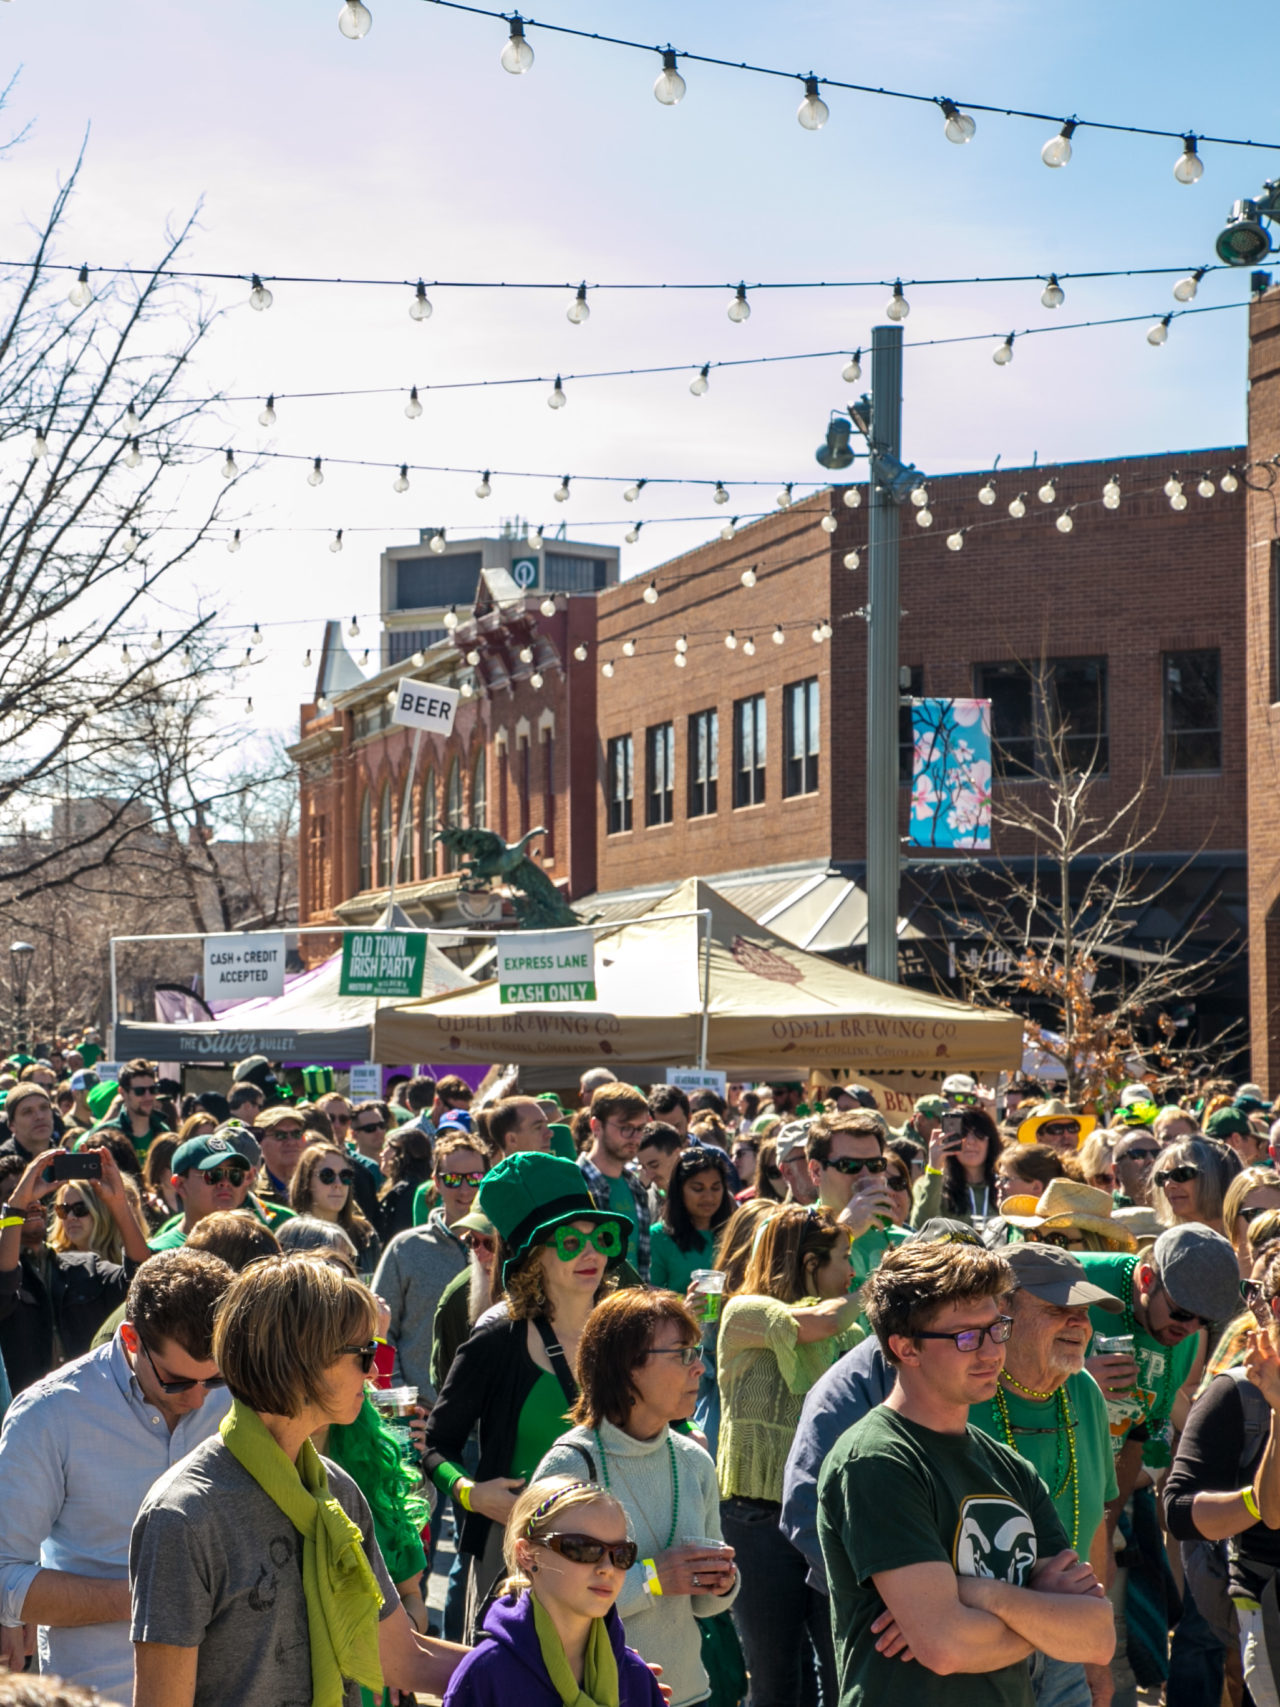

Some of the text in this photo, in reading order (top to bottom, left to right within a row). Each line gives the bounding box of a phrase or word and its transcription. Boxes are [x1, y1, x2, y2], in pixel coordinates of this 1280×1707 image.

[400, 693, 452, 720] BEER
[352, 936, 407, 957] OLD TOWN
[210, 952, 234, 965] CASH
[244, 950, 278, 964] CREDIT
[349, 956, 416, 978] IRISH PARTY
[504, 954, 588, 970] EXPRESS LANE
[219, 969, 268, 983] ACCEPTED
[507, 983, 588, 1002] CASH ONLY
[437, 1015, 497, 1032] ODELL
[501, 1015, 588, 1035] BREWING
[772, 1020, 836, 1039] ODELL
[840, 1019, 926, 1039] BREWING
[180, 1037, 197, 1050] THE
[198, 1032, 258, 1053] Silver
